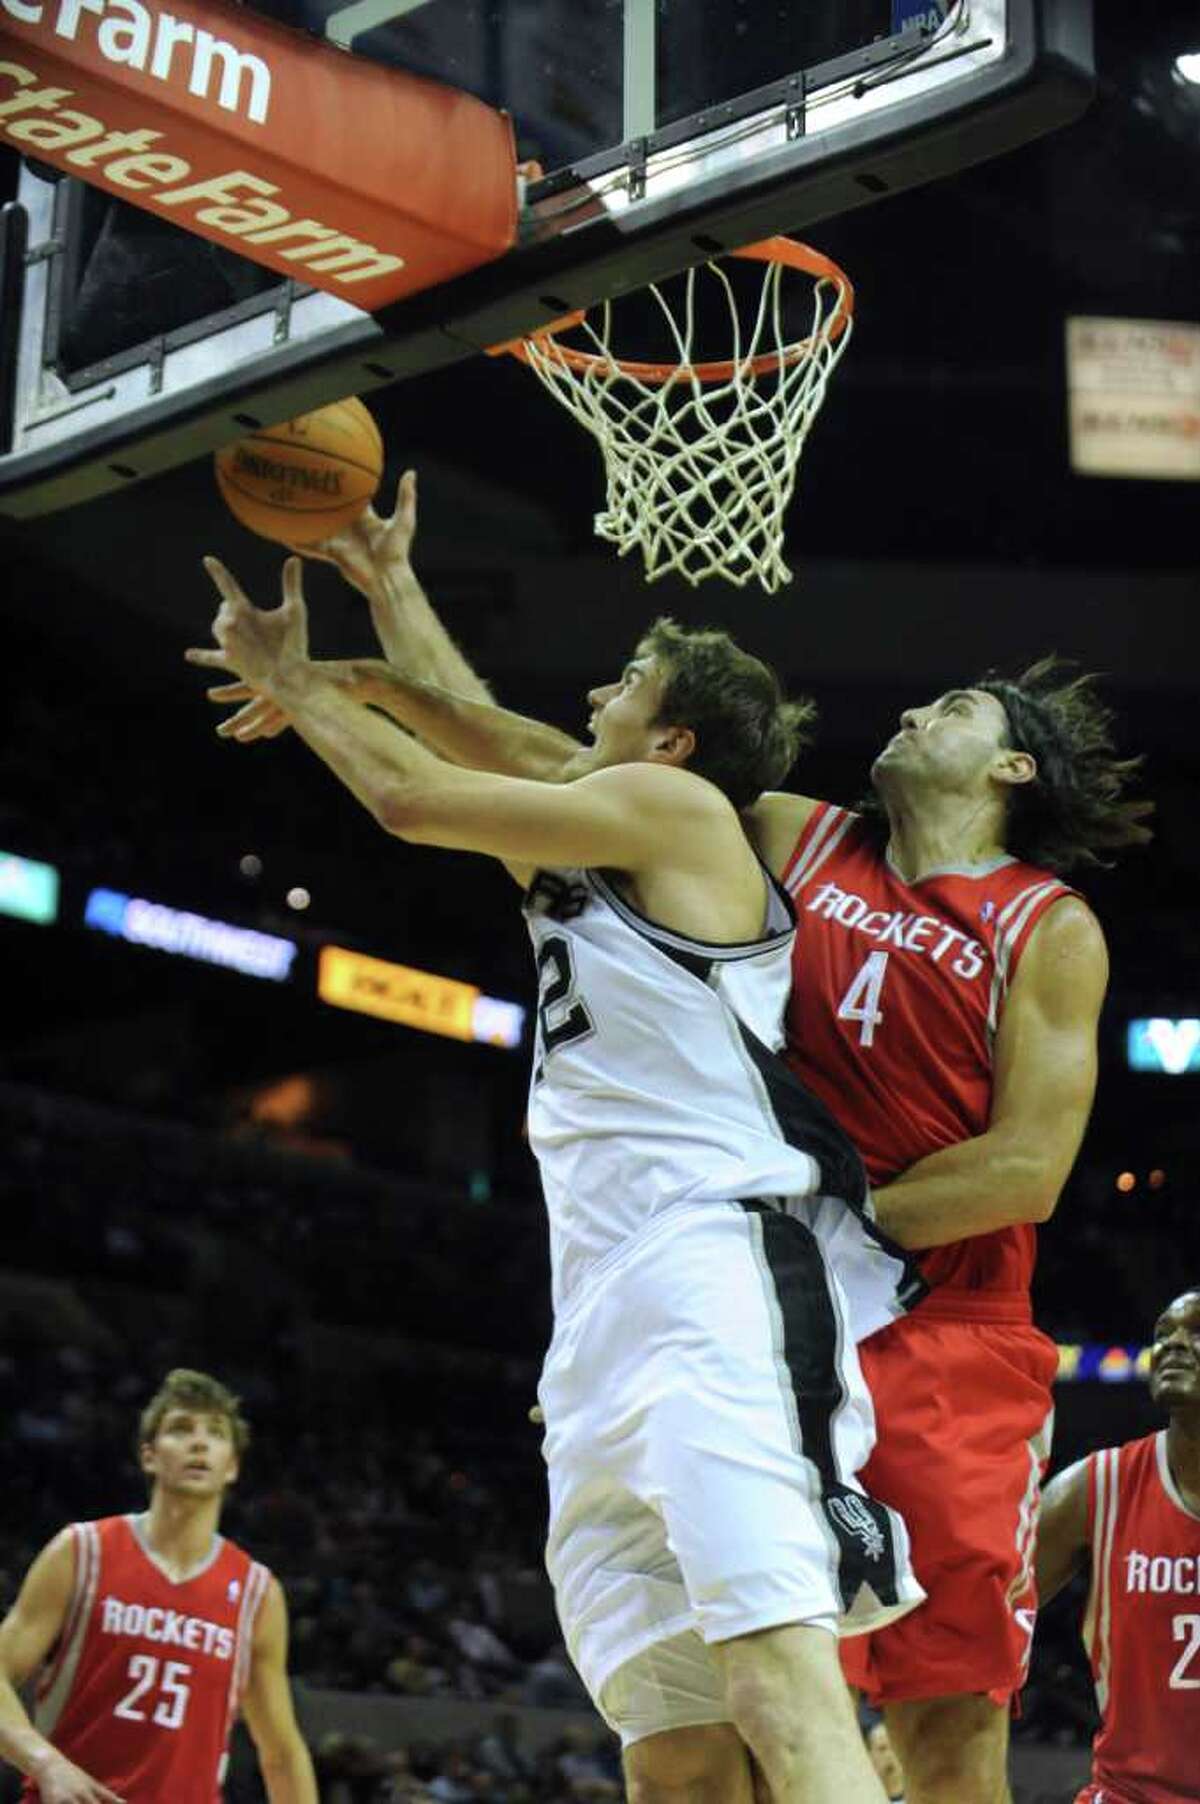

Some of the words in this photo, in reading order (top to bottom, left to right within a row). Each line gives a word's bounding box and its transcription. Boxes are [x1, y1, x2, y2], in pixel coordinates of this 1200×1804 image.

[154, 170, 404, 283] Farm
[805, 882, 988, 980] ROCKETS
[837, 950, 889, 1047] 4
[1124, 1550, 1200, 1594] ROC
[101, 1595, 235, 1661] ROCKETS
[113, 1653, 192, 1730] 25
